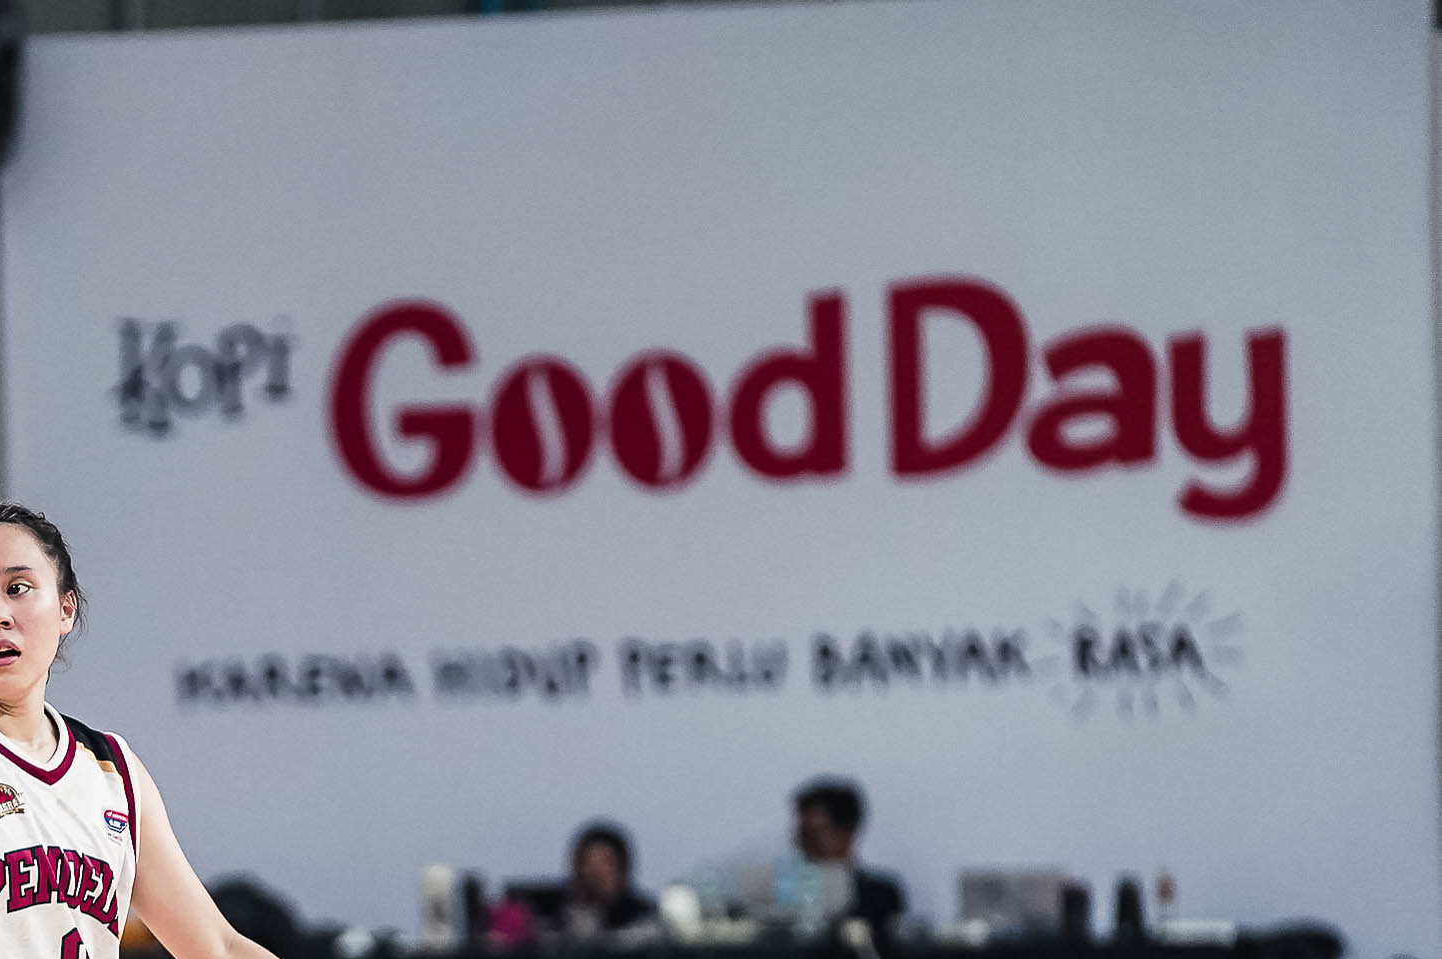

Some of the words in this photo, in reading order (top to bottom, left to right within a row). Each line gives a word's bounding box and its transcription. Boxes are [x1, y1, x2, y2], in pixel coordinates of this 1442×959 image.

[327, 287, 850, 505] Good
[884, 273, 1291, 525] Day
[808, 628, 1034, 696] BANYAK
[1070, 622, 1210, 682] RASA
